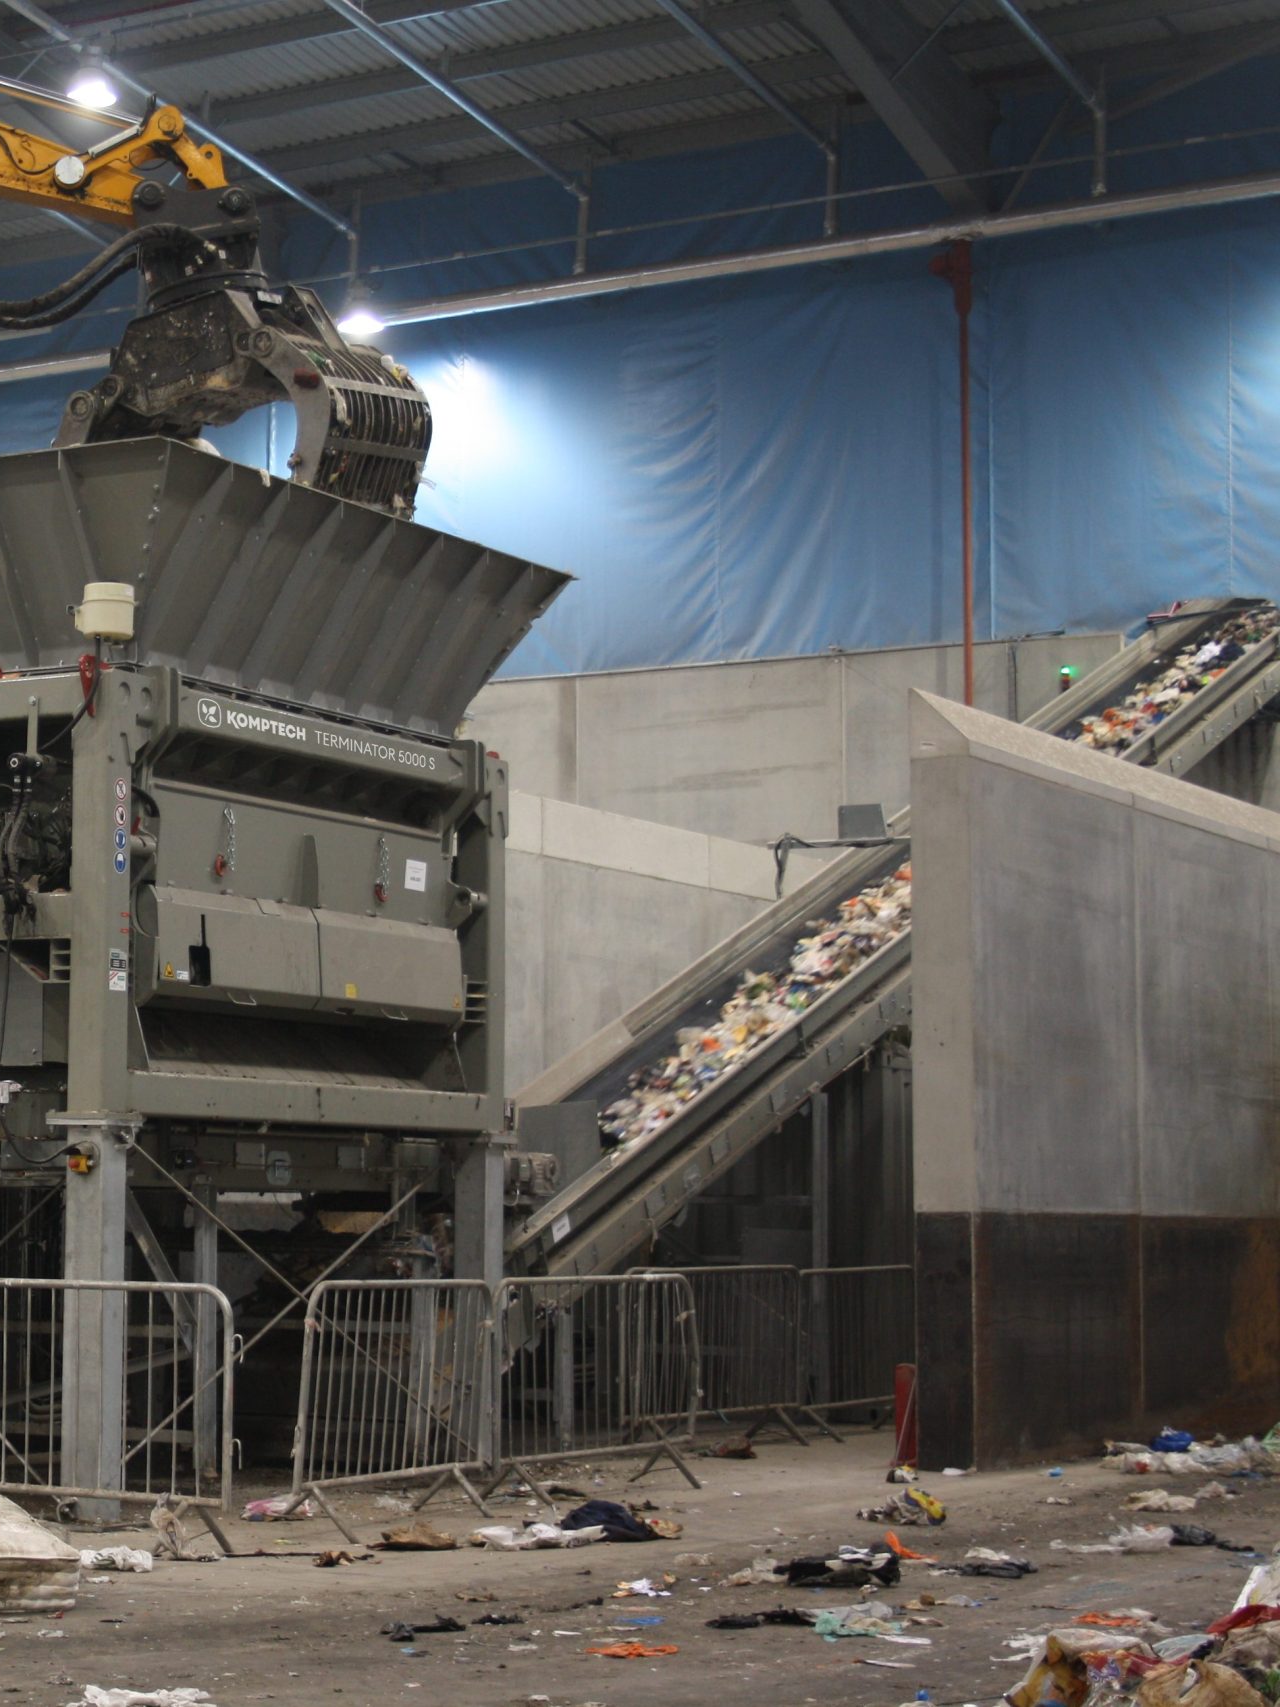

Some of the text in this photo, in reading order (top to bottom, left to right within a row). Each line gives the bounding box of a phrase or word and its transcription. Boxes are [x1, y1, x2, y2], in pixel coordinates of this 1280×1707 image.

[226, 710, 436, 770] KOMPTECH TERMINATOR 5000 S
